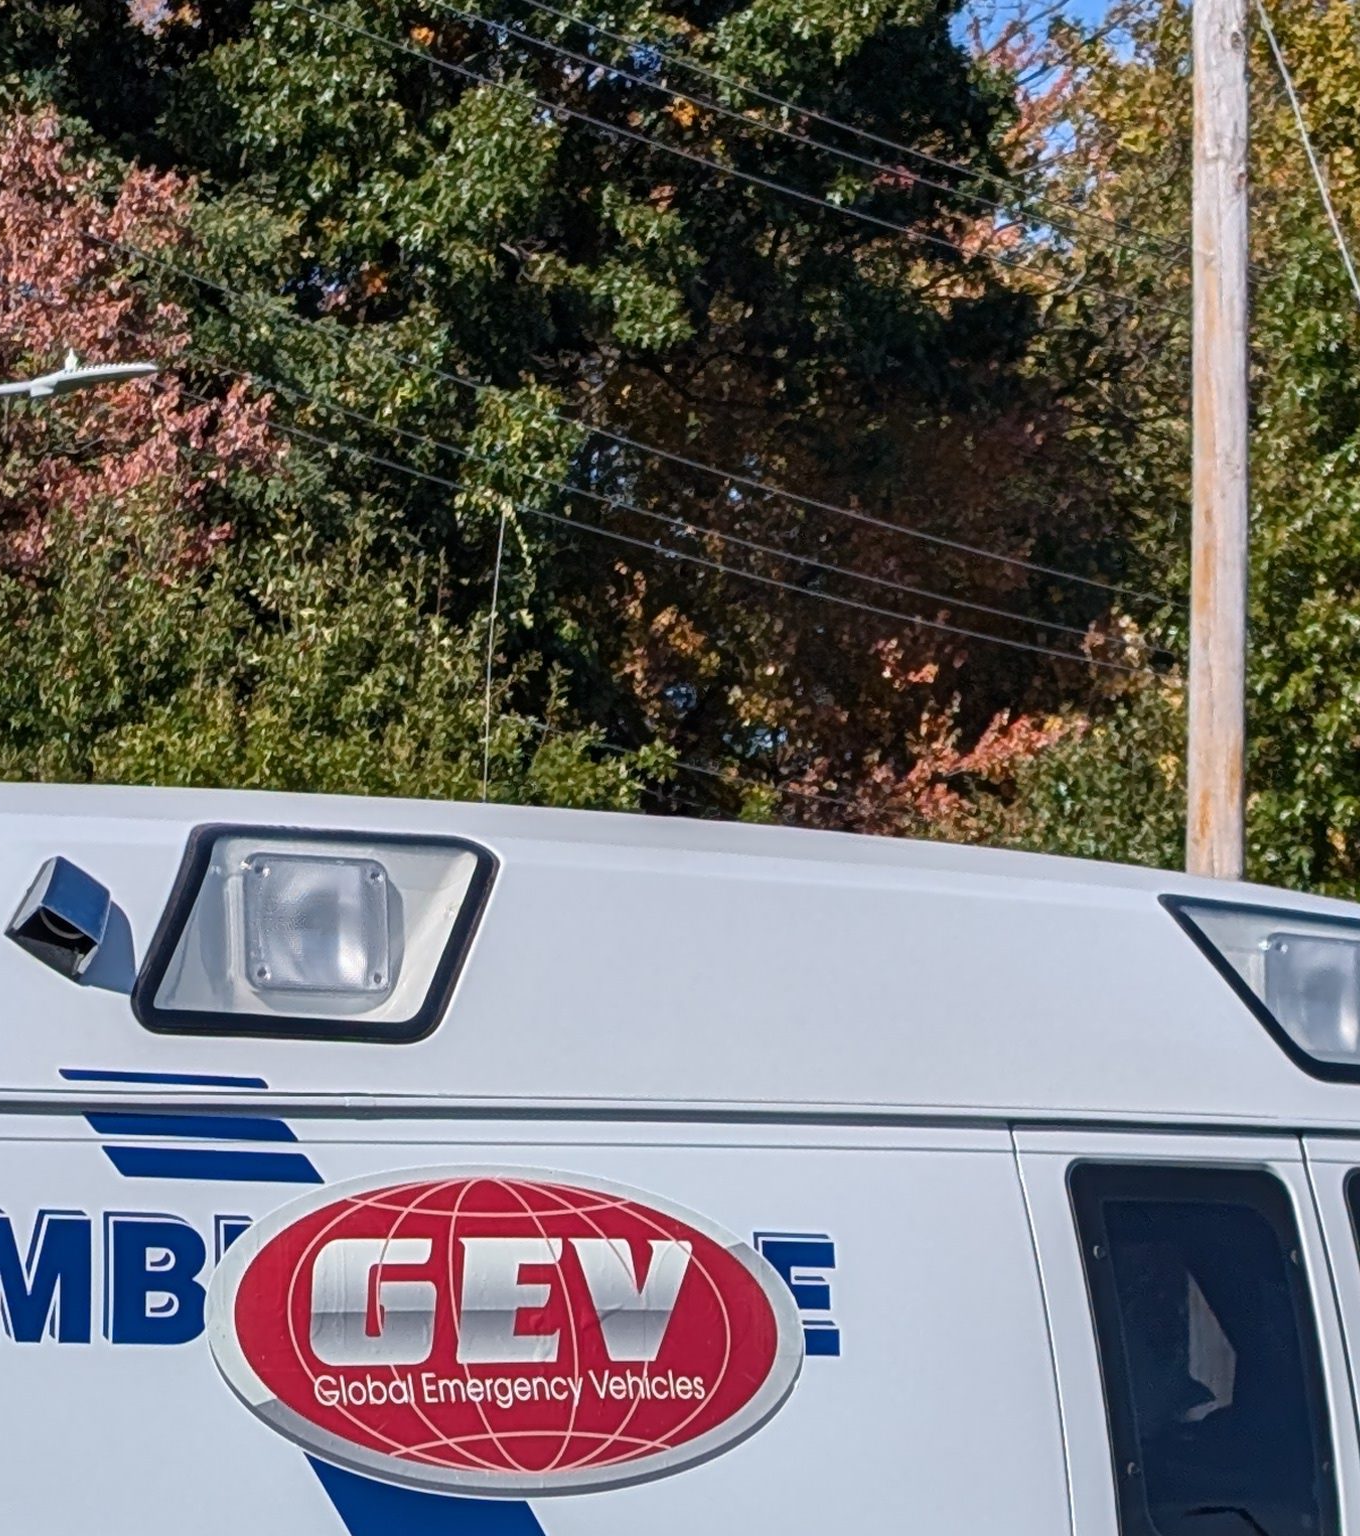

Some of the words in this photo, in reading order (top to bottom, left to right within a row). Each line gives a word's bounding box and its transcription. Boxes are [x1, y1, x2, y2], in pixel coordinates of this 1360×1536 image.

[310, 1237, 692, 1366] GEV
[314, 1373, 415, 1406] Global
[424, 1373, 581, 1408] Emergency
[589, 1370, 705, 1402] Vehicles
